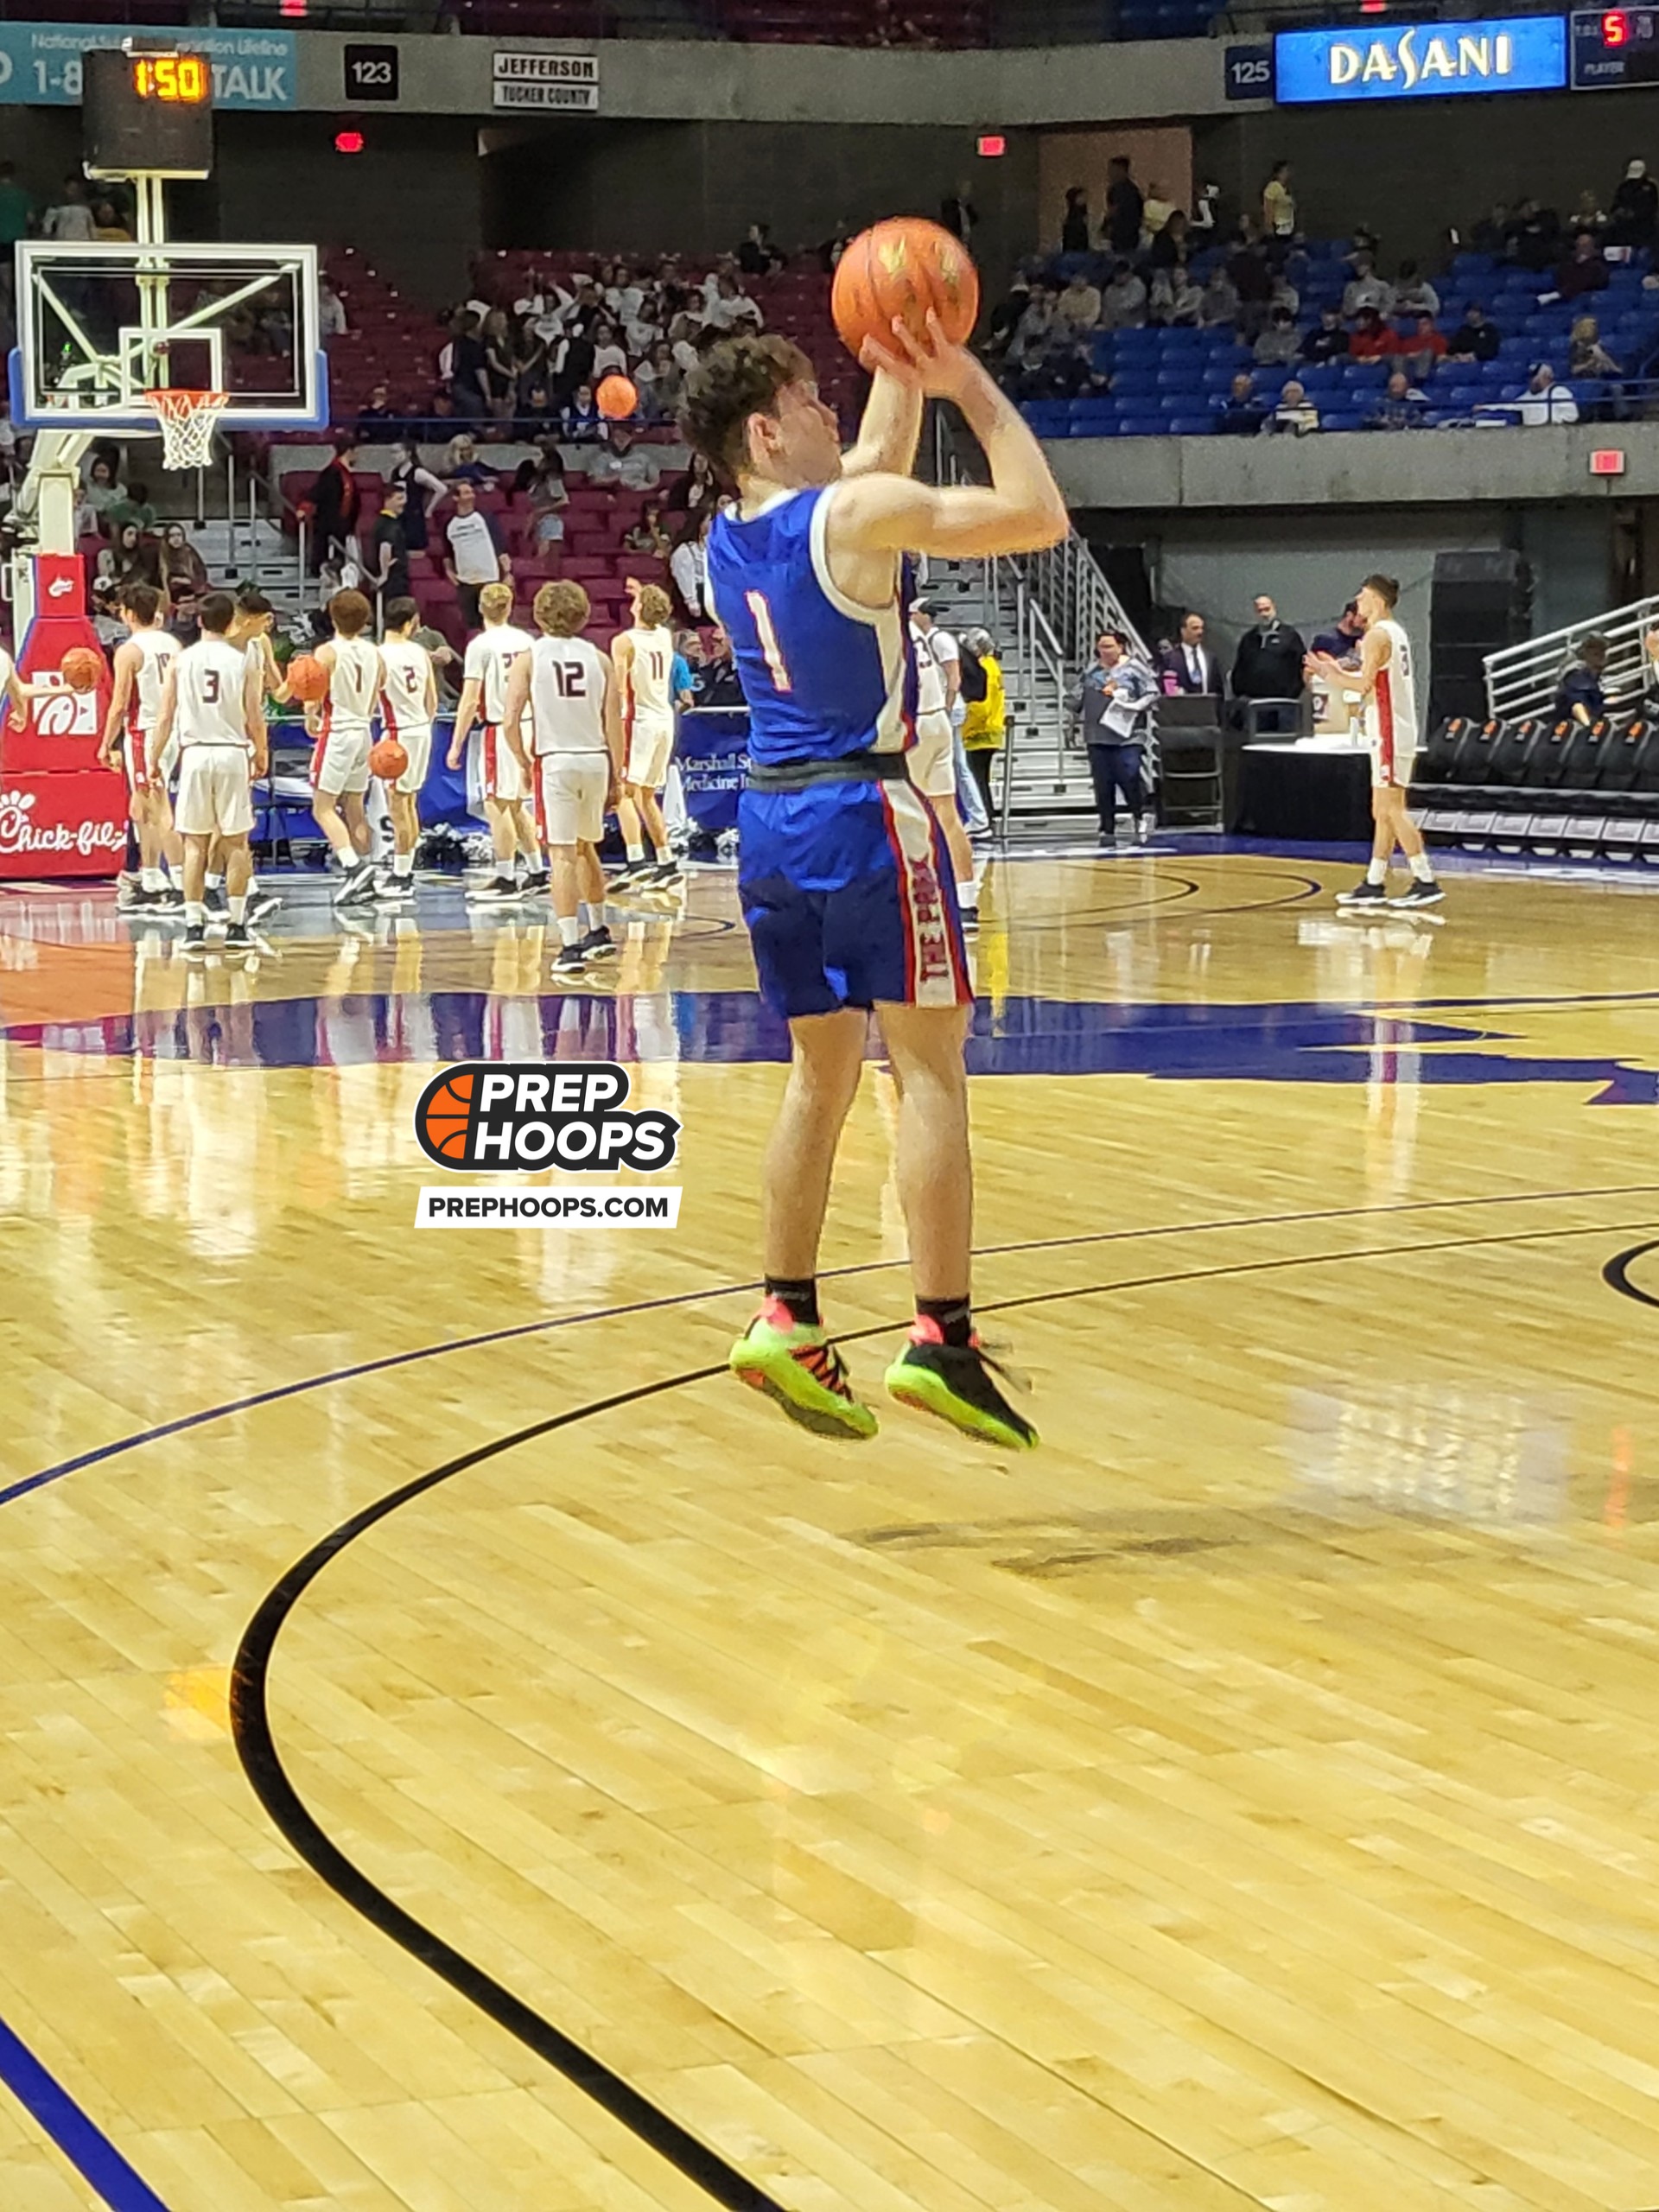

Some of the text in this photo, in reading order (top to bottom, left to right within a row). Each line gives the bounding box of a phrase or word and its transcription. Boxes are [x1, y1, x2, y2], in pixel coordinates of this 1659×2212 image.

[351, 60, 392, 84] 123
[498, 57, 594, 79] JEFFERSON
[1230, 60, 1272, 85] 125
[1330, 27, 1511, 90] DASANI
[134, 58, 200, 101] 1:50
[211, 63, 288, 101] TALK
[503, 85, 544, 103] TUCKER
[742, 588, 793, 694] 1
[354, 663, 363, 694] 1
[403, 664, 418, 695] 2
[552, 659, 587, 697] 12
[649, 650, 664, 681] 11
[201, 668, 220, 704] 3
[675, 753, 736, 772] Marshall
